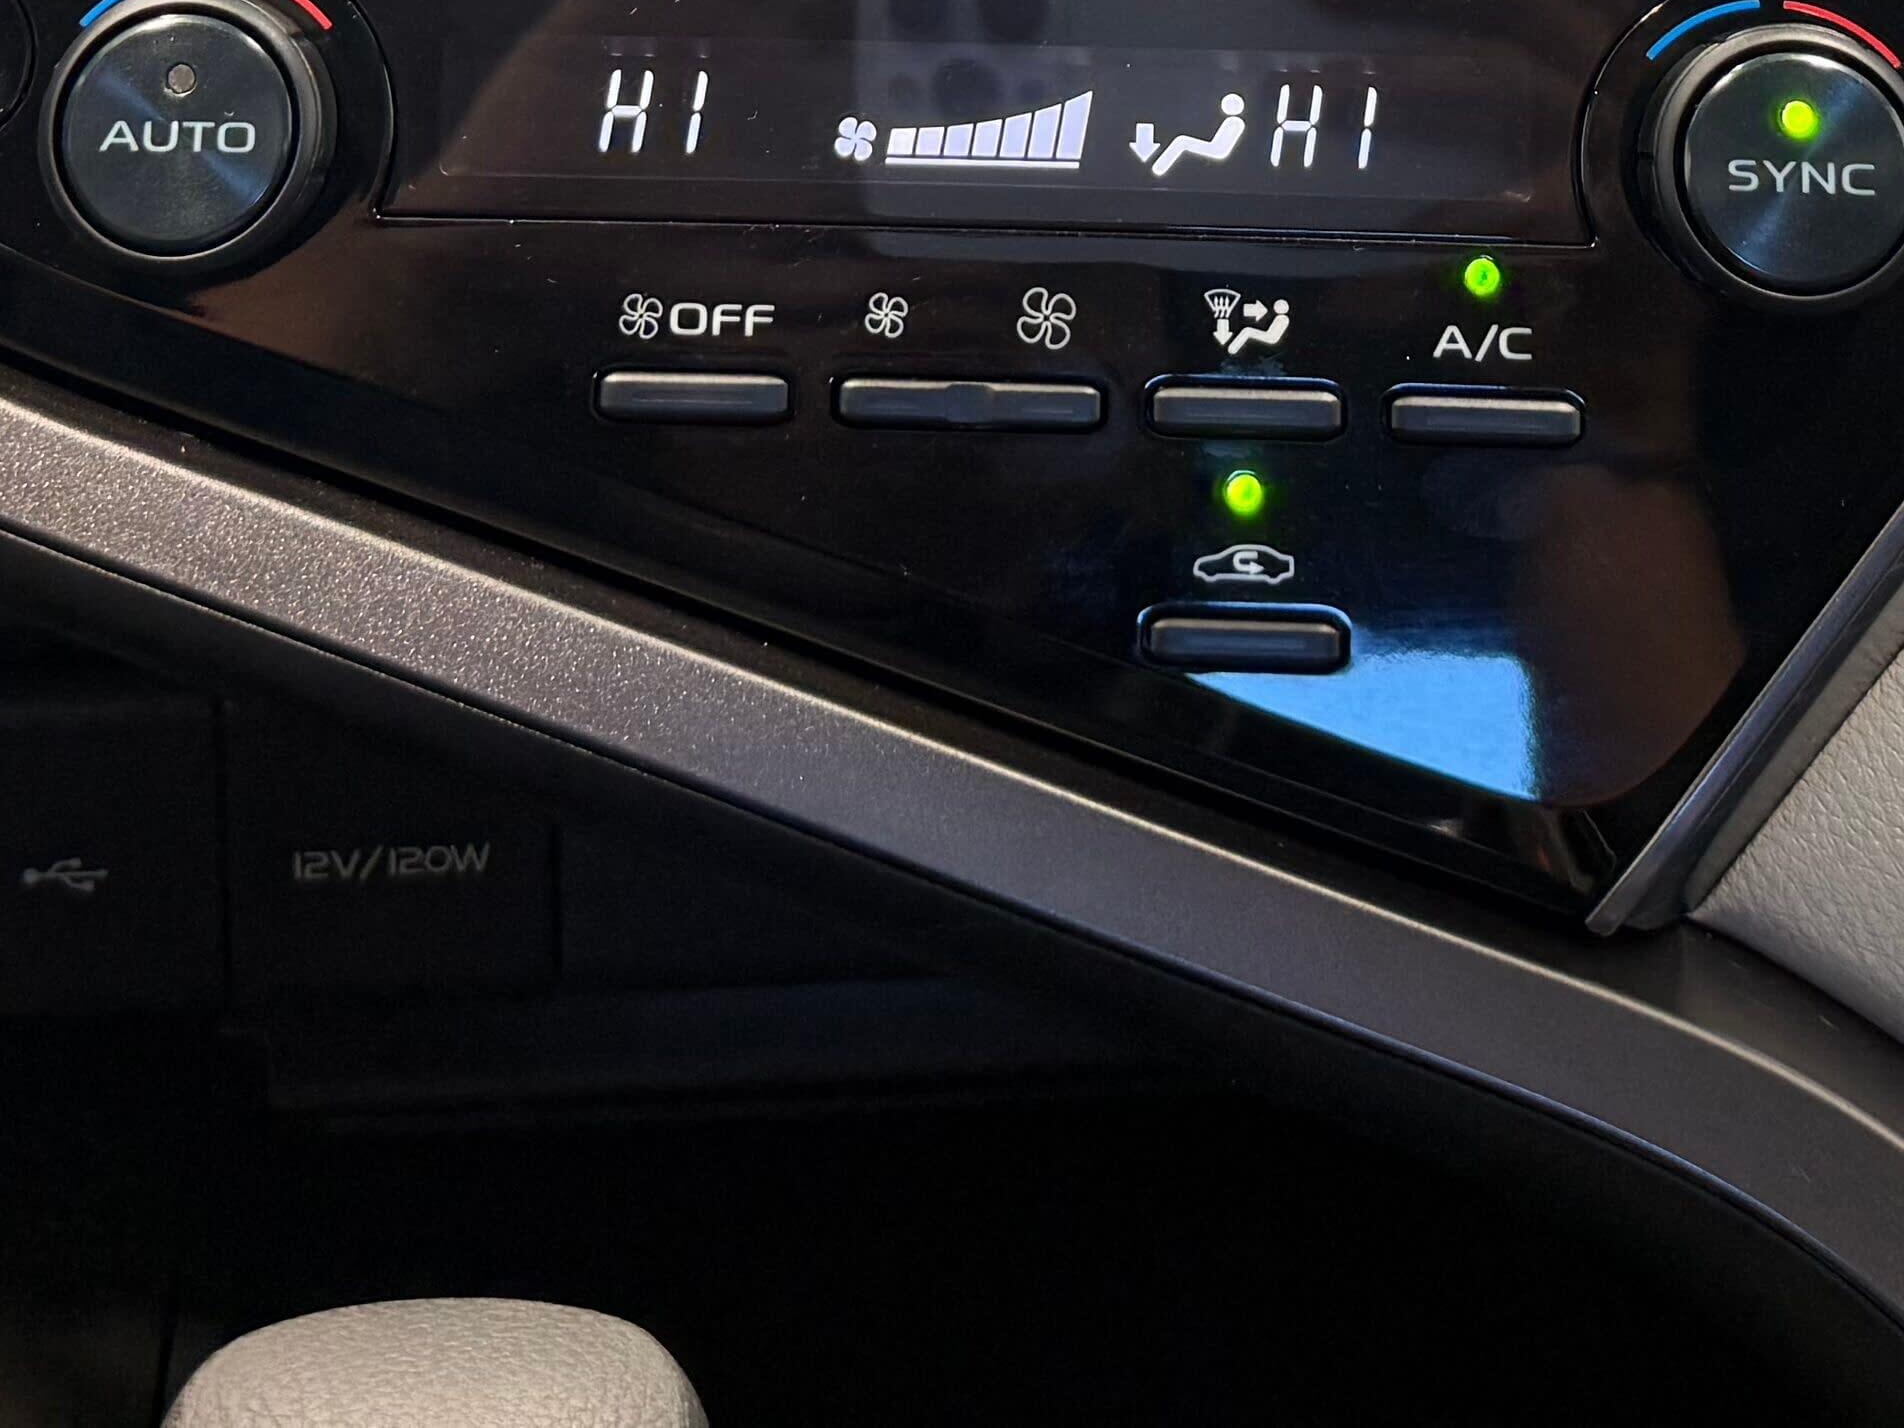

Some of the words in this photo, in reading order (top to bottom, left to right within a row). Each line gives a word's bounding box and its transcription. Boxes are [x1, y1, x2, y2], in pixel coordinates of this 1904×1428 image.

[99, 119, 256, 153] AUTO
[1727, 158, 1876, 197] SYNC
[670, 303, 776, 336] OFF
[1433, 324, 1533, 361] A/C
[293, 843, 491, 881] 12V/120W
